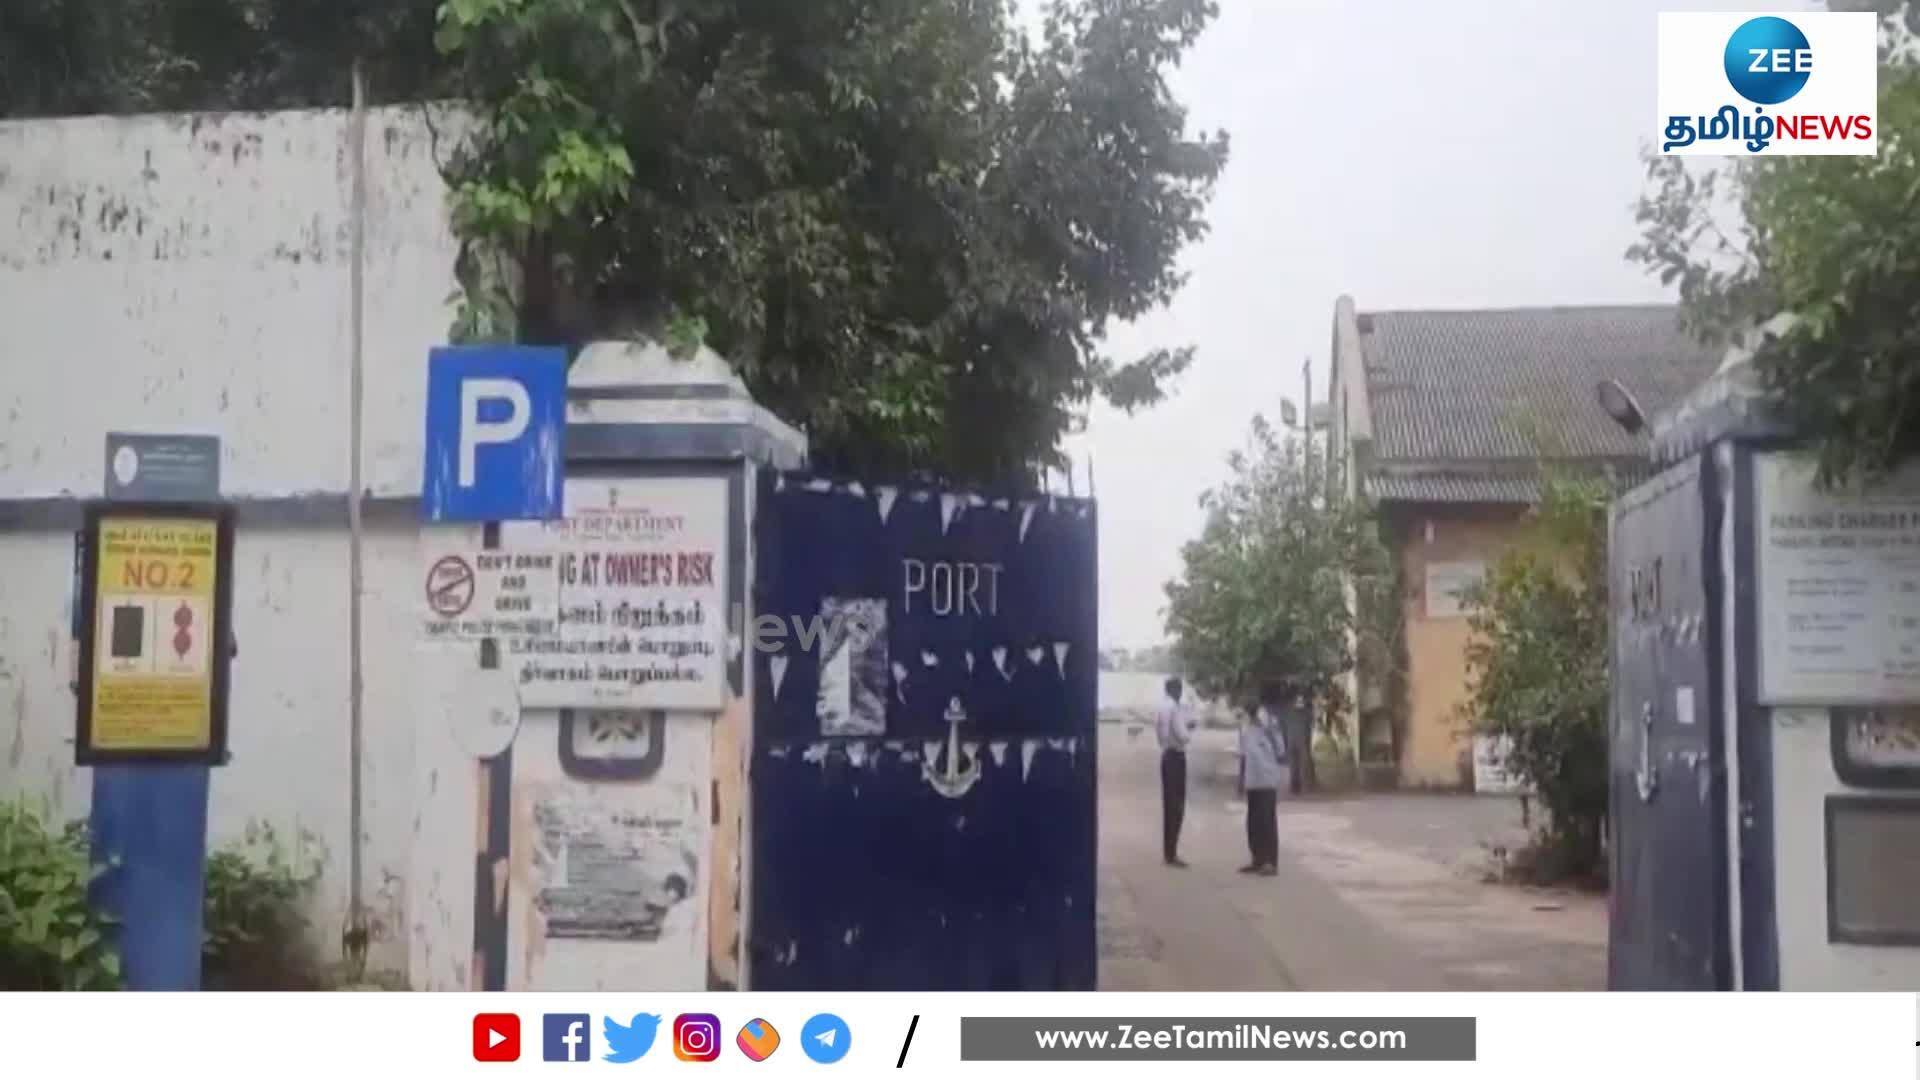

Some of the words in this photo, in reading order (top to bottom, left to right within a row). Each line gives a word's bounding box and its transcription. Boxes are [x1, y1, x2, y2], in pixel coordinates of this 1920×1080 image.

[459, 378, 532, 488] P
[581, 552, 600, 586] AT
[605, 552, 673, 587] OWNER'S
[677, 552, 715, 588] RISK
[903, 559, 1003, 617] PORT
